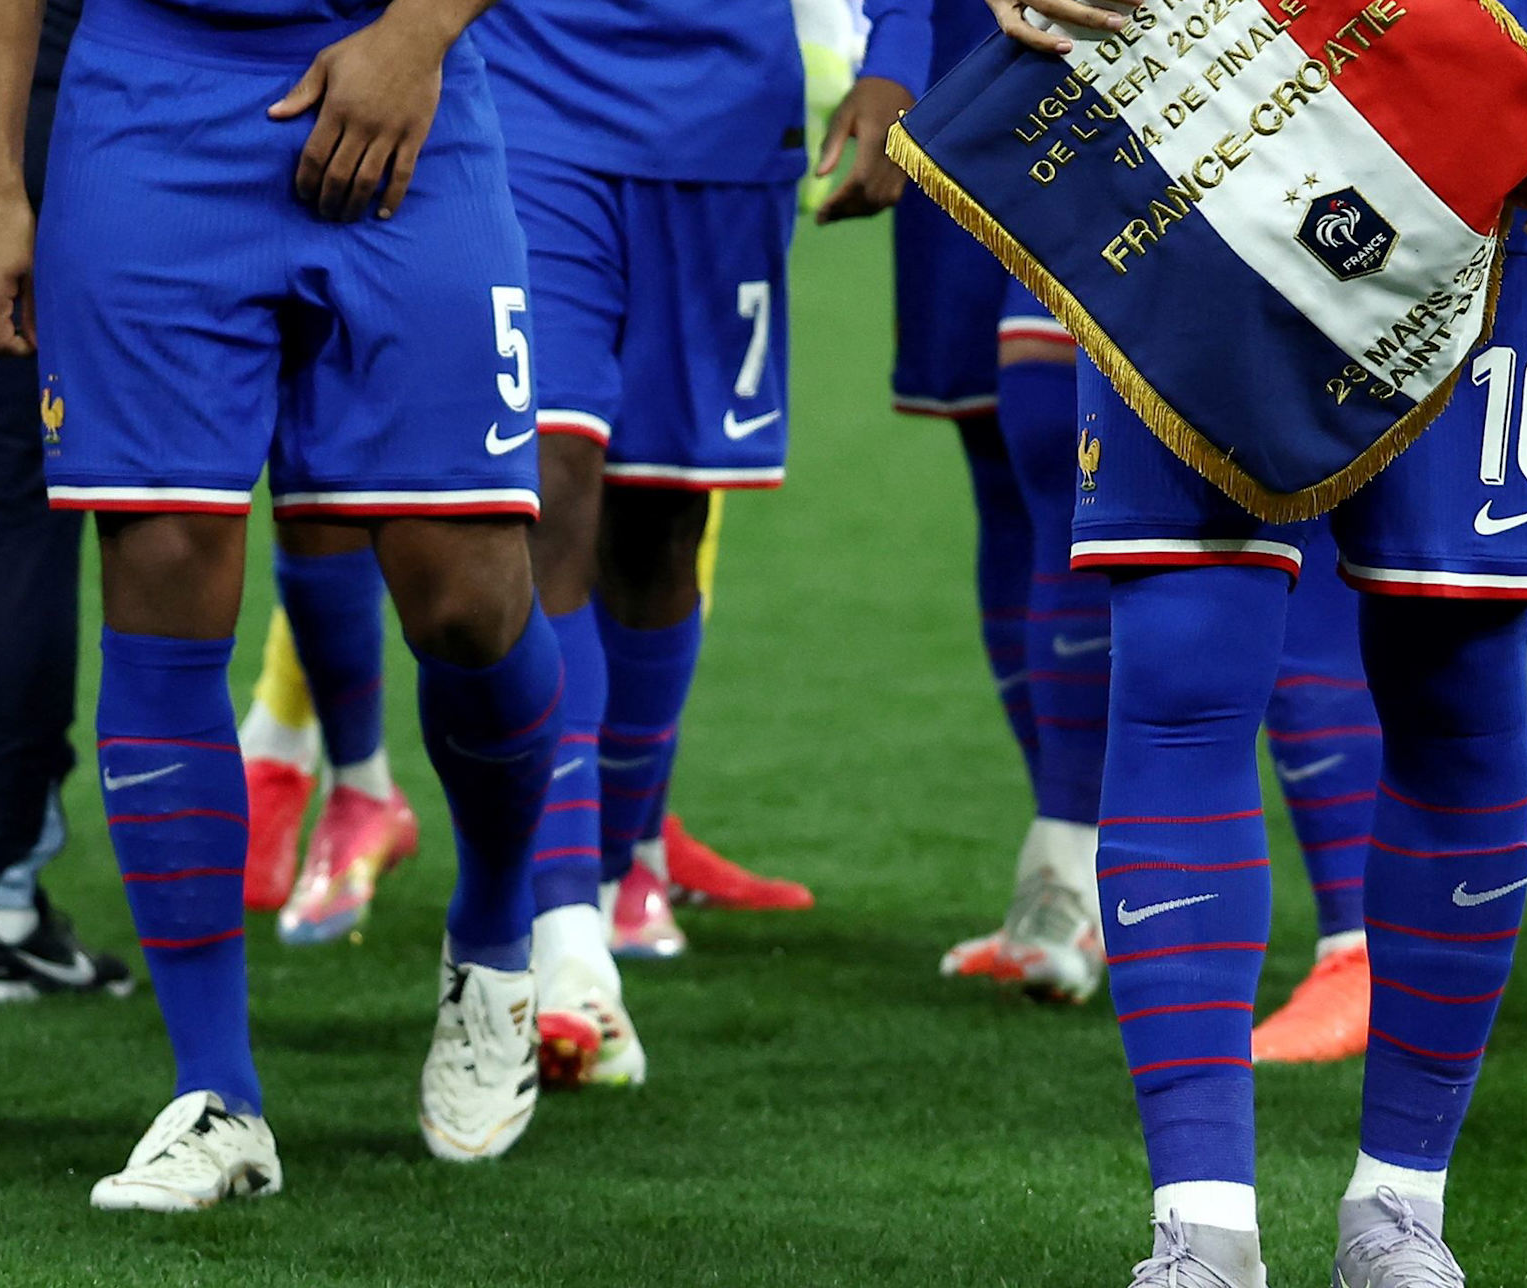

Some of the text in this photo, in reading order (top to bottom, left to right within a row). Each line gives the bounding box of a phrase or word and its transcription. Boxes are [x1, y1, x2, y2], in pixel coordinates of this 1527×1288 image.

[1014, 60, 1101, 144] LIGUE
[1094, 3, 1159, 64] DES
[1027, 139, 1076, 187] DE
[1071, 53, 1170, 142] L'UEFA
[1113, 123, 1165, 171] 1/4
[1161, 82, 1210, 130] DE
[1342, 232, 1387, 271] FRANCE
[490, 285, 533, 414] 5
[734, 279, 772, 400] 7
[1325, 363, 1369, 406] 23
[1362, 290, 1454, 368] MARS
